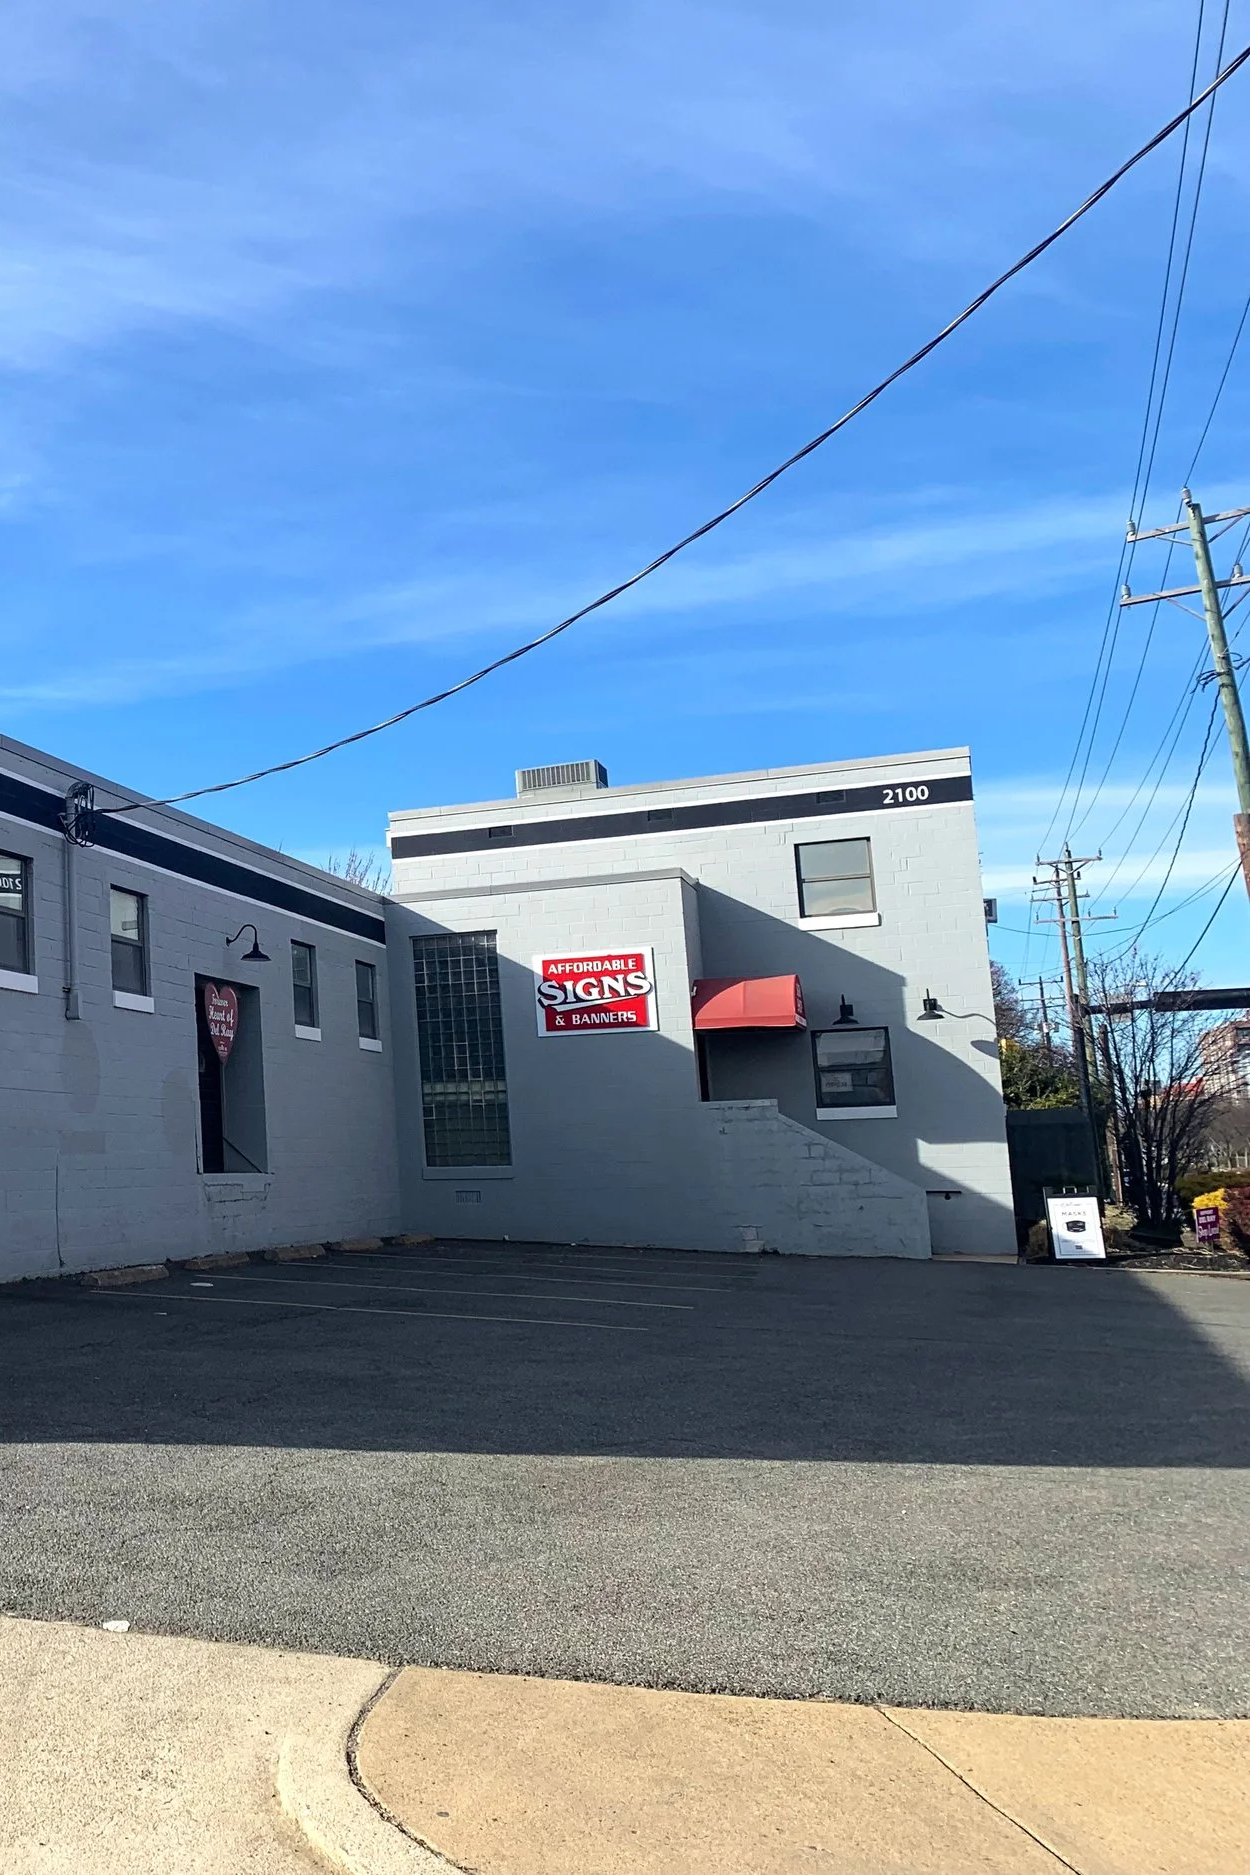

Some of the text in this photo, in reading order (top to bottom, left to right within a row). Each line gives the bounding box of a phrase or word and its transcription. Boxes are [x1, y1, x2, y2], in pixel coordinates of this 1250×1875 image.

[882, 785, 929, 804] 2100
[547, 958, 637, 975] AFFORDABLE
[538, 971, 651, 1007] SIGNS
[209, 1005, 234, 1027] Heart of
[555, 1010, 637, 1026] & BANNERS
[220, 1023, 234, 1042] Ray
